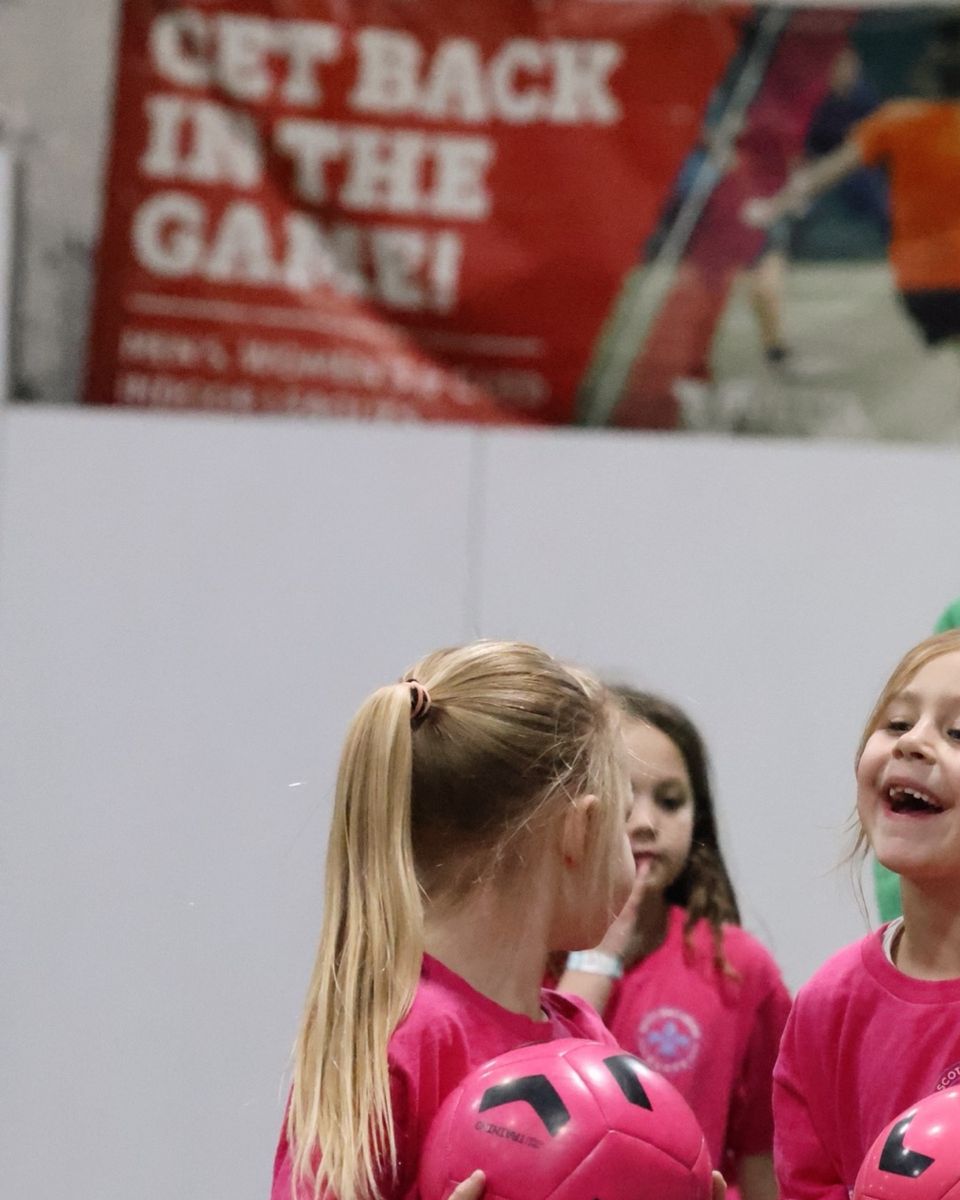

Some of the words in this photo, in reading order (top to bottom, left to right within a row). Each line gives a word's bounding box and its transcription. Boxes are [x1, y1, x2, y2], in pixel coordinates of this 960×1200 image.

[149, 9, 340, 103] GET
[348, 27, 624, 124] BACK
[141, 94, 263, 188] IN
[273, 117, 494, 220] THE
